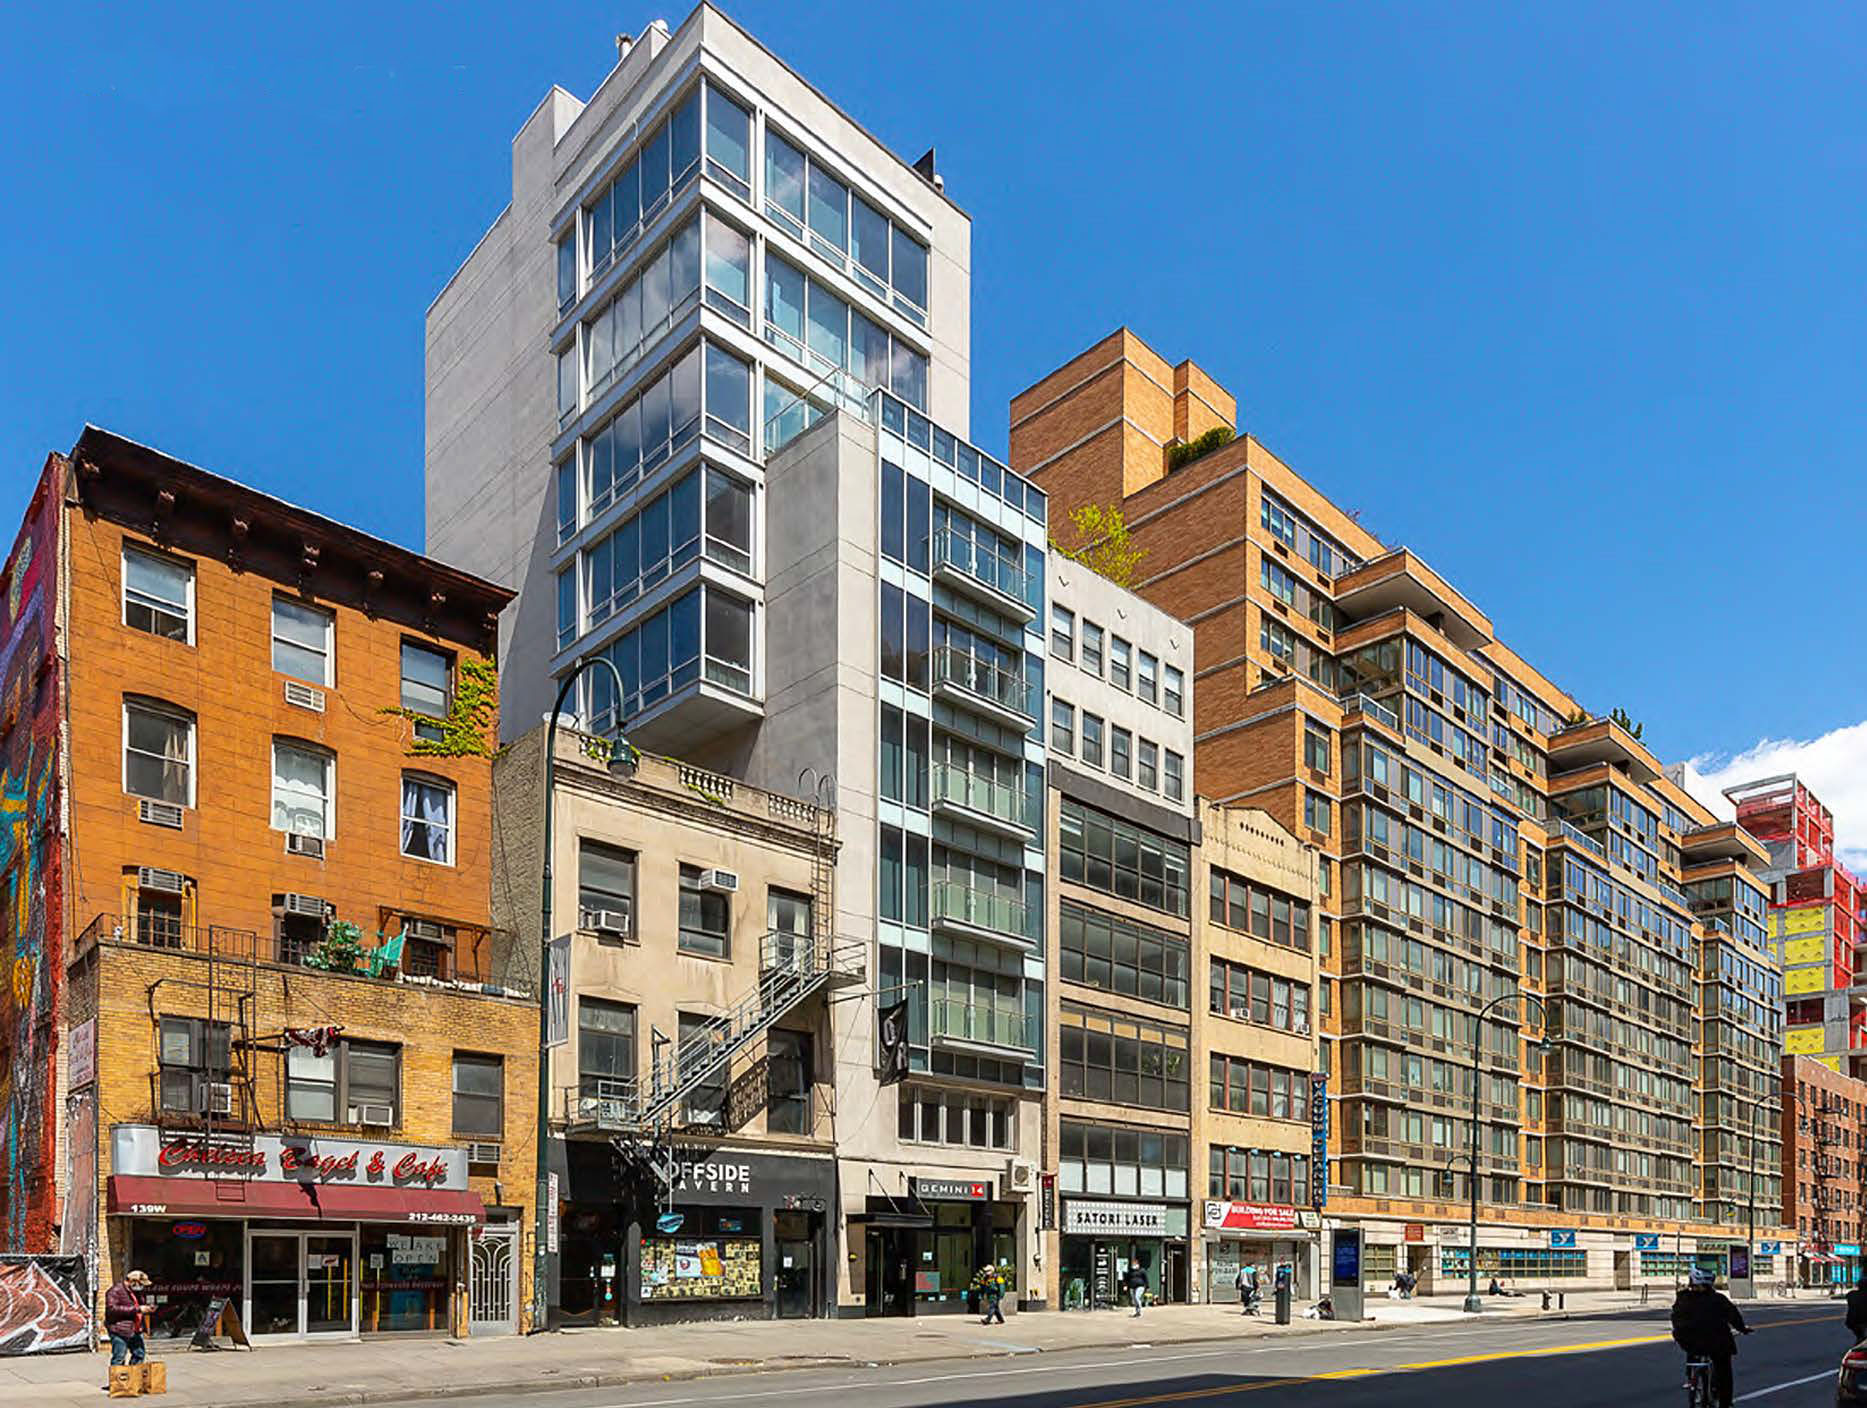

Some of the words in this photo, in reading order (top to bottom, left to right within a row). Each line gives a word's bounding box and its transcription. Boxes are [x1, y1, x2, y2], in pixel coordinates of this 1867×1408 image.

[159, 1139, 266, 1167] Chelsea
[279, 1147, 360, 1176] Bagel
[367, 1150, 385, 1174] &
[663, 1161, 750, 1182] OFFSIDE
[664, 1180, 750, 1193] AVERN
[920, 1184, 968, 1194] GEMINI
[971, 1184, 984, 1195] 14
[1264, 1207, 1278, 1216] FOR
[1279, 1208, 1295, 1217] SALE
[1077, 1212, 1120, 1225] SATORI
[1125, 1214, 1158, 1226] LASER
[394, 1253, 438, 1263] OPEN
